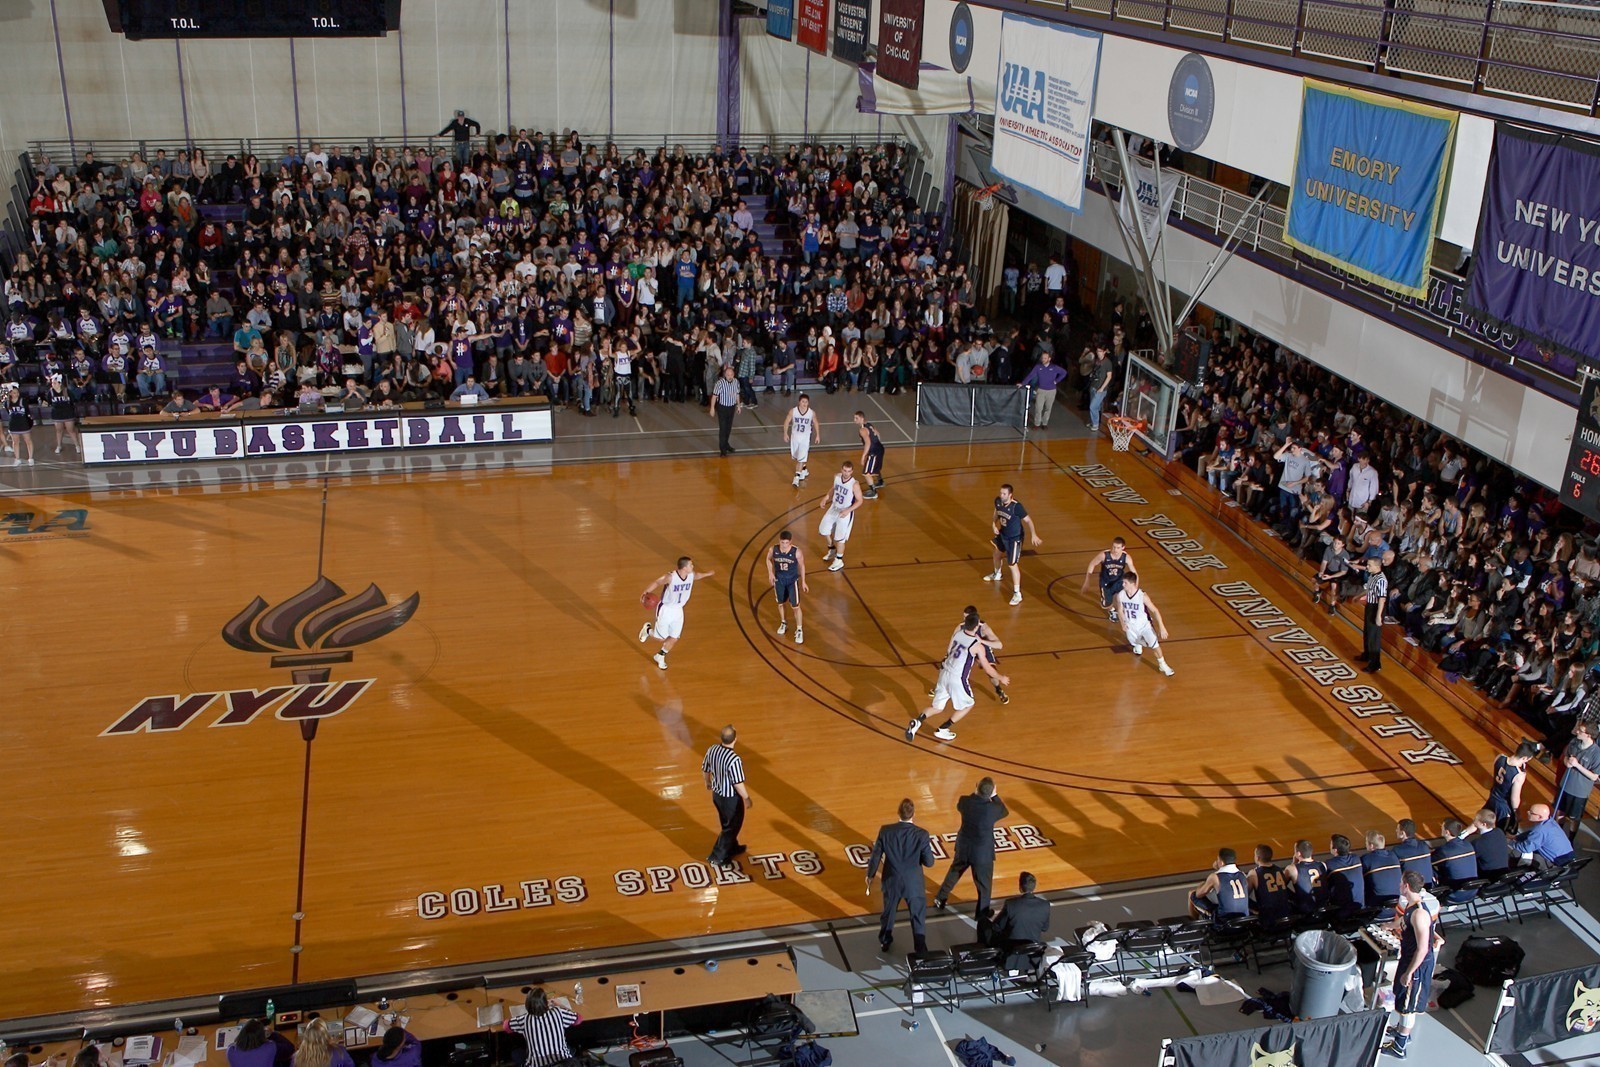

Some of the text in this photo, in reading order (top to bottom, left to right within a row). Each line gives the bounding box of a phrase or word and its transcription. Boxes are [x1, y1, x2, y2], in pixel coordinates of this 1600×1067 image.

[171, 18, 200, 29] T.O.L.
[312, 17, 340, 28] T.O.L.
[839, 15, 863, 32] RESERVE
[883, 12, 917, 31] UNIVERSITY
[837, 27, 865, 45] UNIVERSITY
[894, 31, 903, 43] OF
[885, 43, 910, 61] CHICAGO
[1001, 61, 1046, 124] UAA
[999, 116, 1025, 133] UNIVERSITY
[1025, 124, 1048, 141] ATHLETIC
[1329, 146, 1401, 185] EMORY
[1306, 178, 1416, 232] UNIVERSITY
[1514, 199, 1571, 235] NEW
[794, 417, 810, 425] NYU
[796, 424, 806, 433] 13
[101, 413, 522, 460] NYU BASKETBALL
[1580, 449, 1600, 475] 26
[1571, 471, 1586, 484] FOULS
[835, 493, 845, 504] 33
[1573, 483, 1581, 498] 6
[1069, 463, 1229, 572] NEW YORK
[779, 562, 789, 571] 12
[673, 583, 691, 592] NYU
[677, 593, 682, 604] 1
[1121, 601, 1140, 611] NYU
[1126, 610, 1137, 619] 15
[1210, 580, 1464, 766] UNIVERSITY
[97, 677, 378, 737] NYU
[417, 875, 588, 919] COLES
[613, 849, 823, 897] SPORTS
[1264, 871, 1287, 893] 24
[1308, 868, 1322, 888] 2
[1229, 878, 1246, 899] 11
